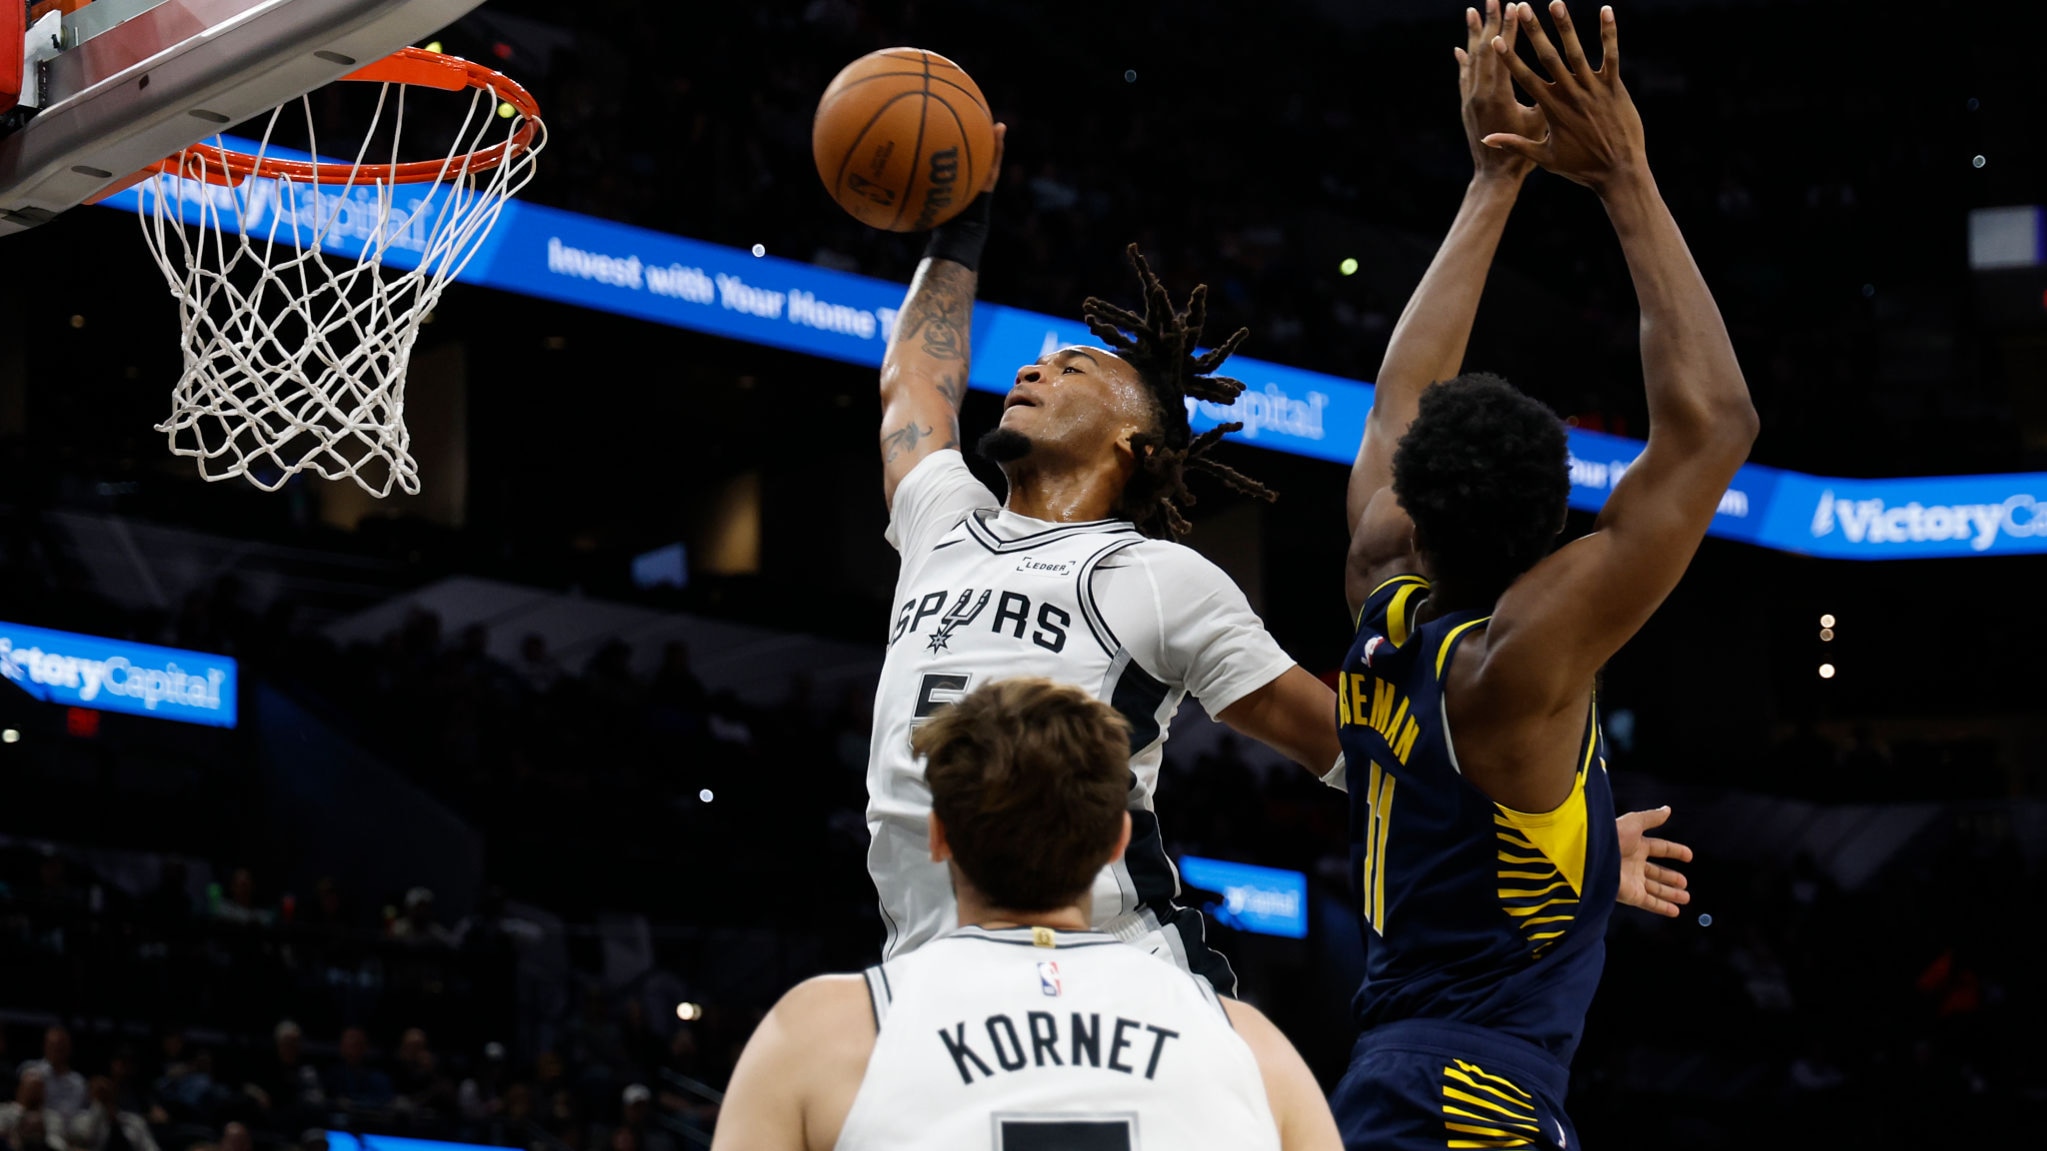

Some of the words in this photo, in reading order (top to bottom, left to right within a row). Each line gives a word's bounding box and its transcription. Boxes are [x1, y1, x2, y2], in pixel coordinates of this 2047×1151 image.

[548, 236, 643, 290] Invest
[645, 262, 715, 305] with
[715, 272, 786, 319] Your
[788, 288, 876, 339] Home
[1025, 561, 1067, 571] LEDGER
[890, 588, 1071, 655] SPURS
[1364, 759, 1397, 938] 11
[937, 1010, 1181, 1086] KORNET
